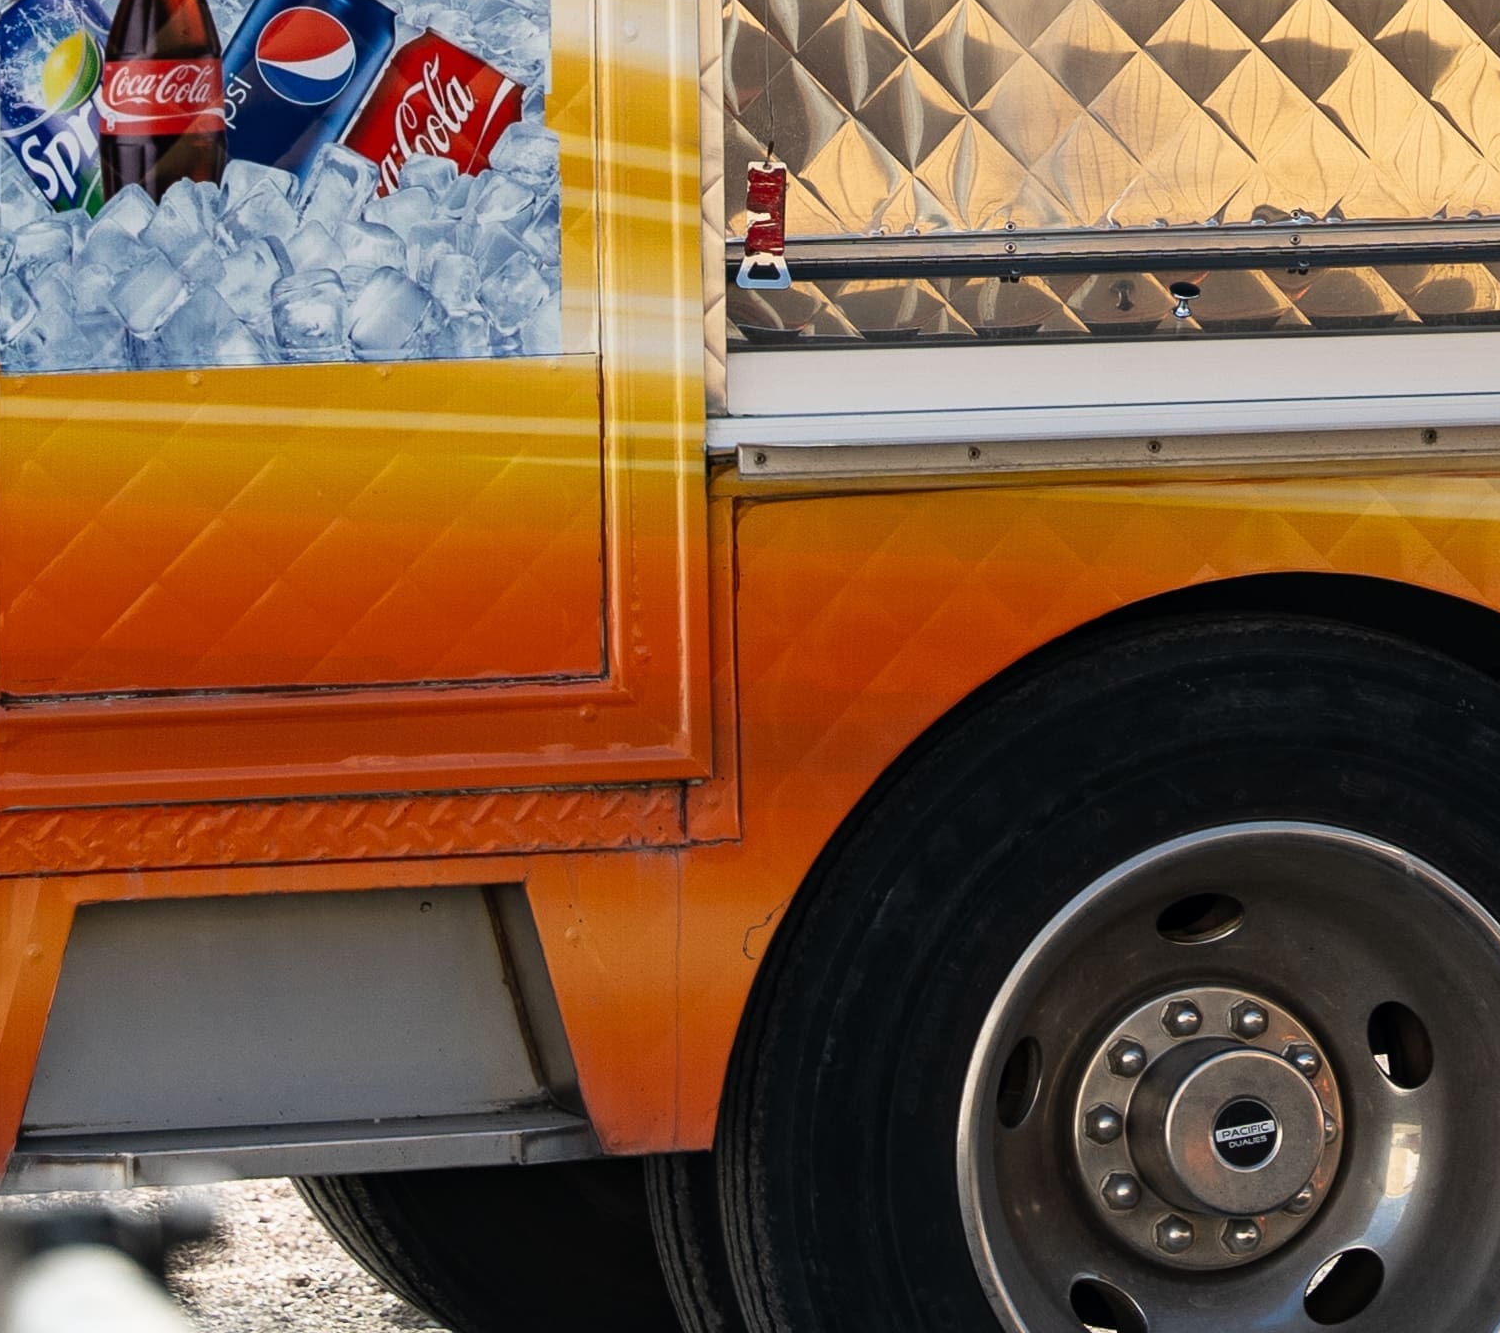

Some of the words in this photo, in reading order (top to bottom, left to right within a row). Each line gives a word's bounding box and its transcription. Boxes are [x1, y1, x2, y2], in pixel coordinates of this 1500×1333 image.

[107, 64, 214, 107] Coca-Cola
[1221, 1122, 1269, 1139] PACIFIC
[1228, 1134, 1268, 1148] DUALIES
